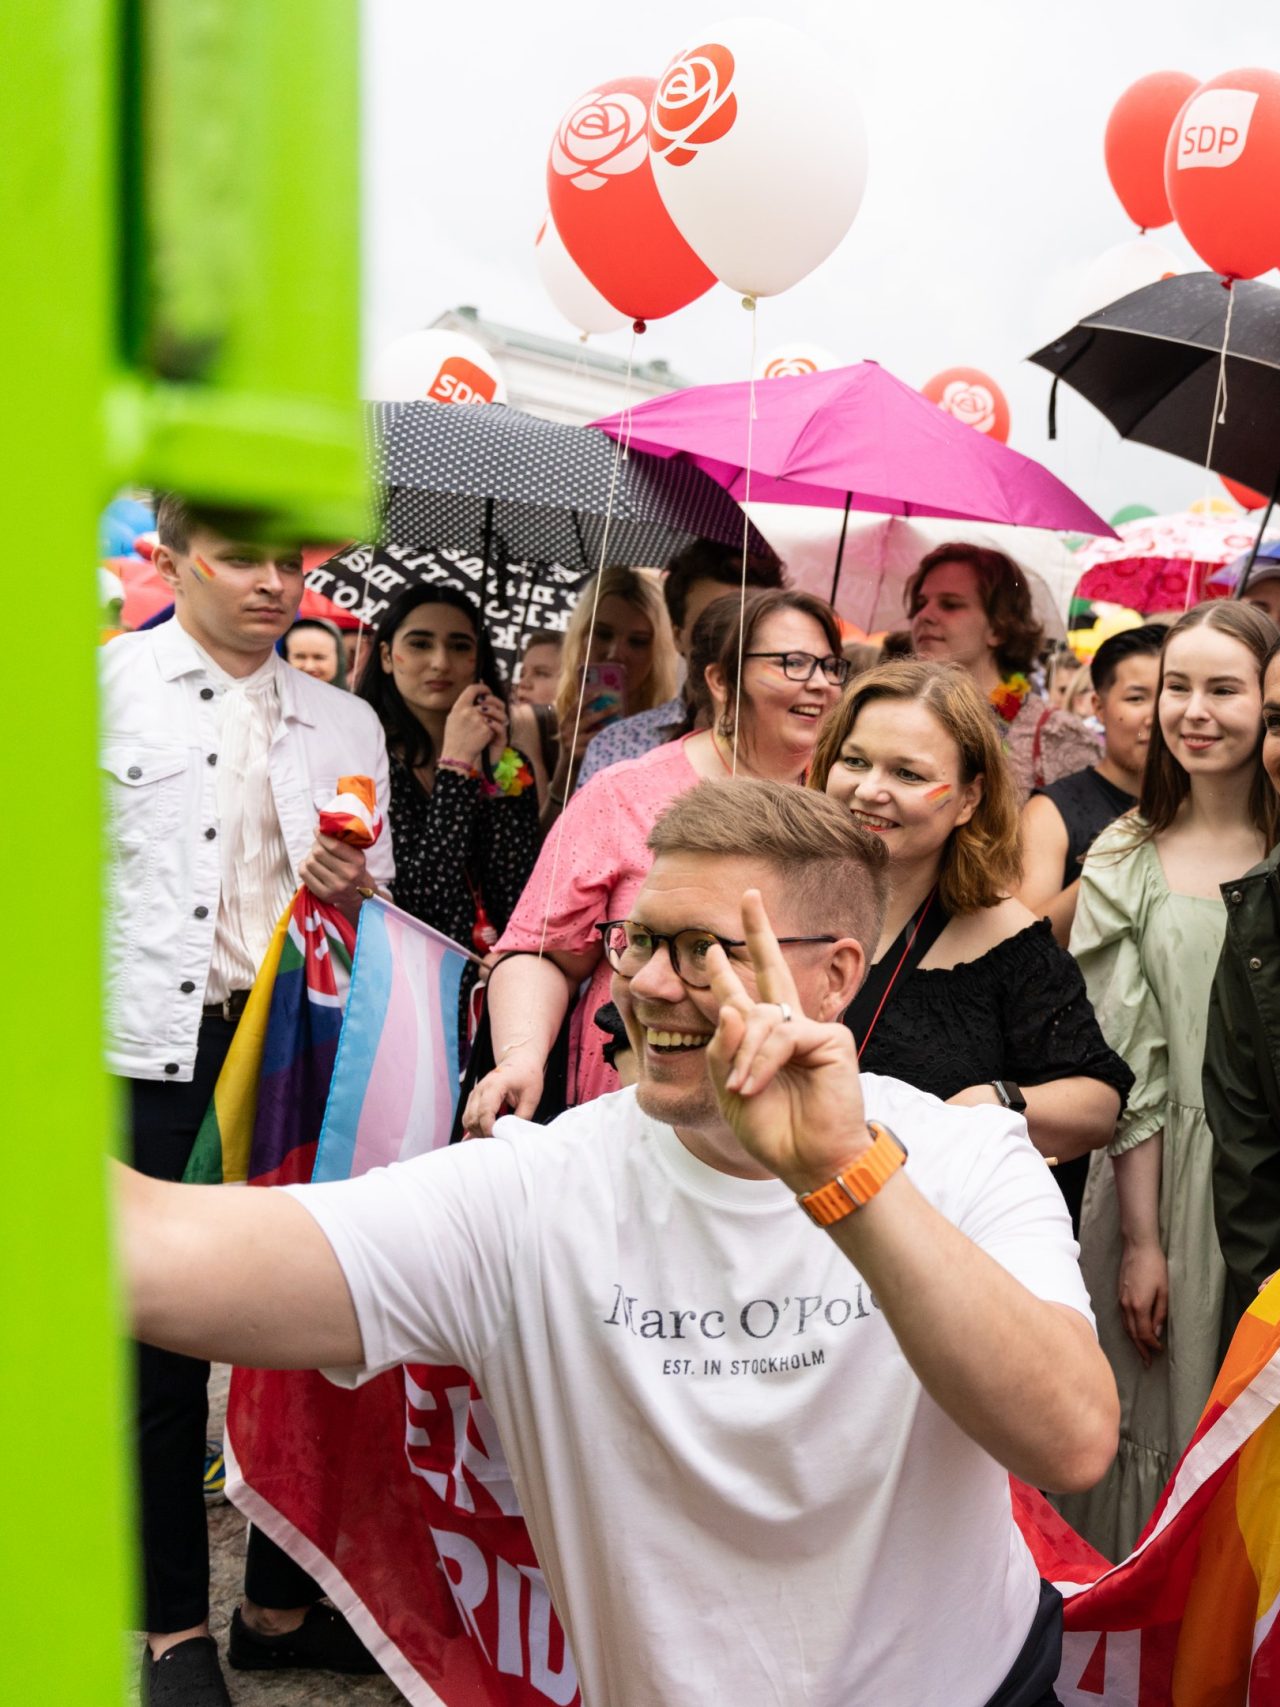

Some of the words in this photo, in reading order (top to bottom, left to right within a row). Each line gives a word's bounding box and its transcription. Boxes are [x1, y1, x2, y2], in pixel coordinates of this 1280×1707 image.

[1183, 126, 1239, 155] SDP
[740, 1282, 881, 1339] O'Pol
[663, 1358, 695, 1376] EST.
[704, 1360, 722, 1376] IN
[730, 1349, 826, 1376] STOCKHOLM
